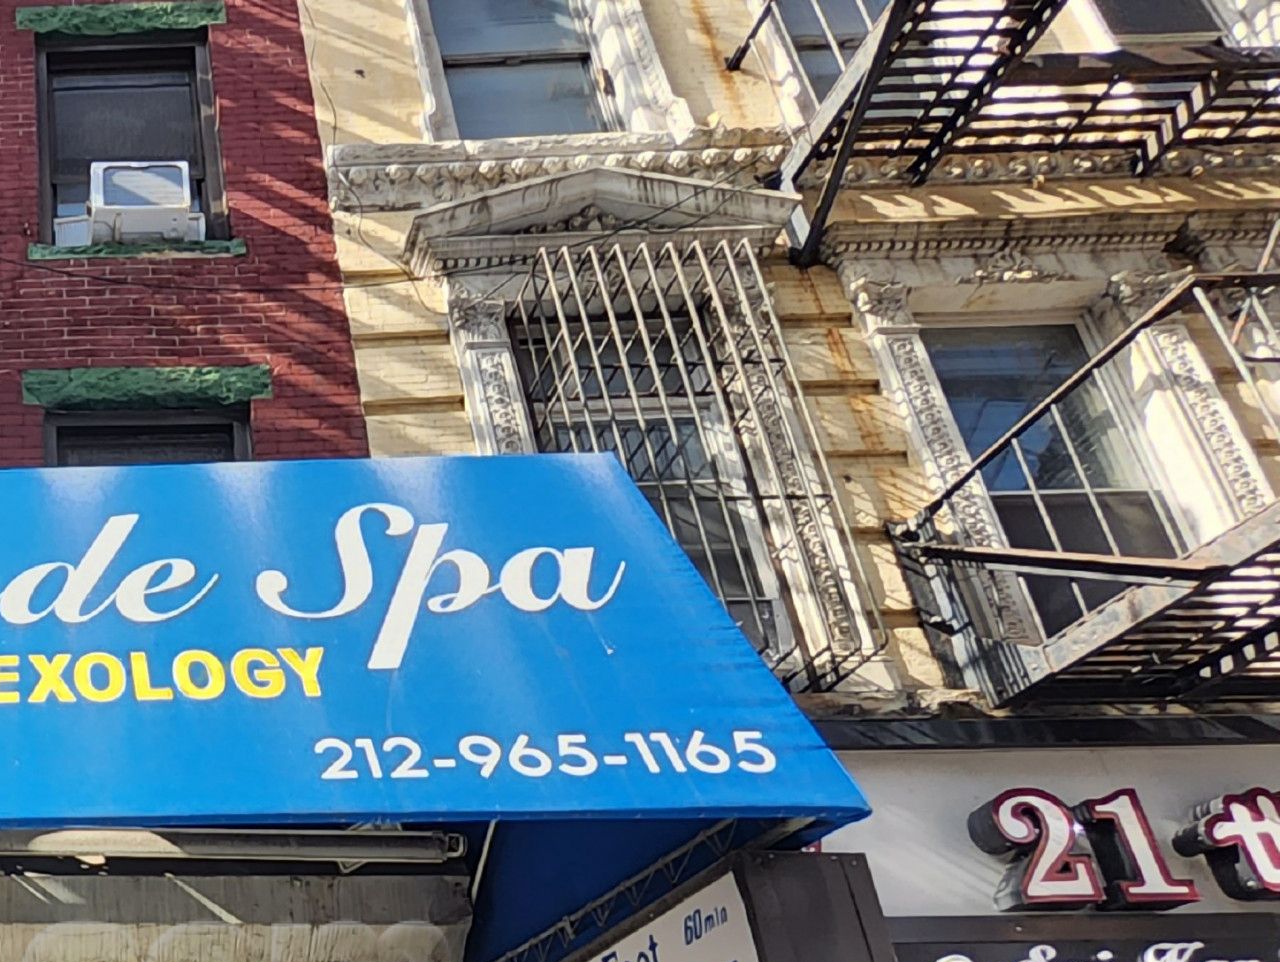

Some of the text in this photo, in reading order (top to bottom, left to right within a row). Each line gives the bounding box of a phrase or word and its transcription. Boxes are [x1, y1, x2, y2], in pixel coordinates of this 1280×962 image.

[257, 503, 625, 670] Spa
[315, 729, 776, 782] 212-965-1165
[992, 788, 1202, 906] 21
[683, 905, 728, 946] 60min
